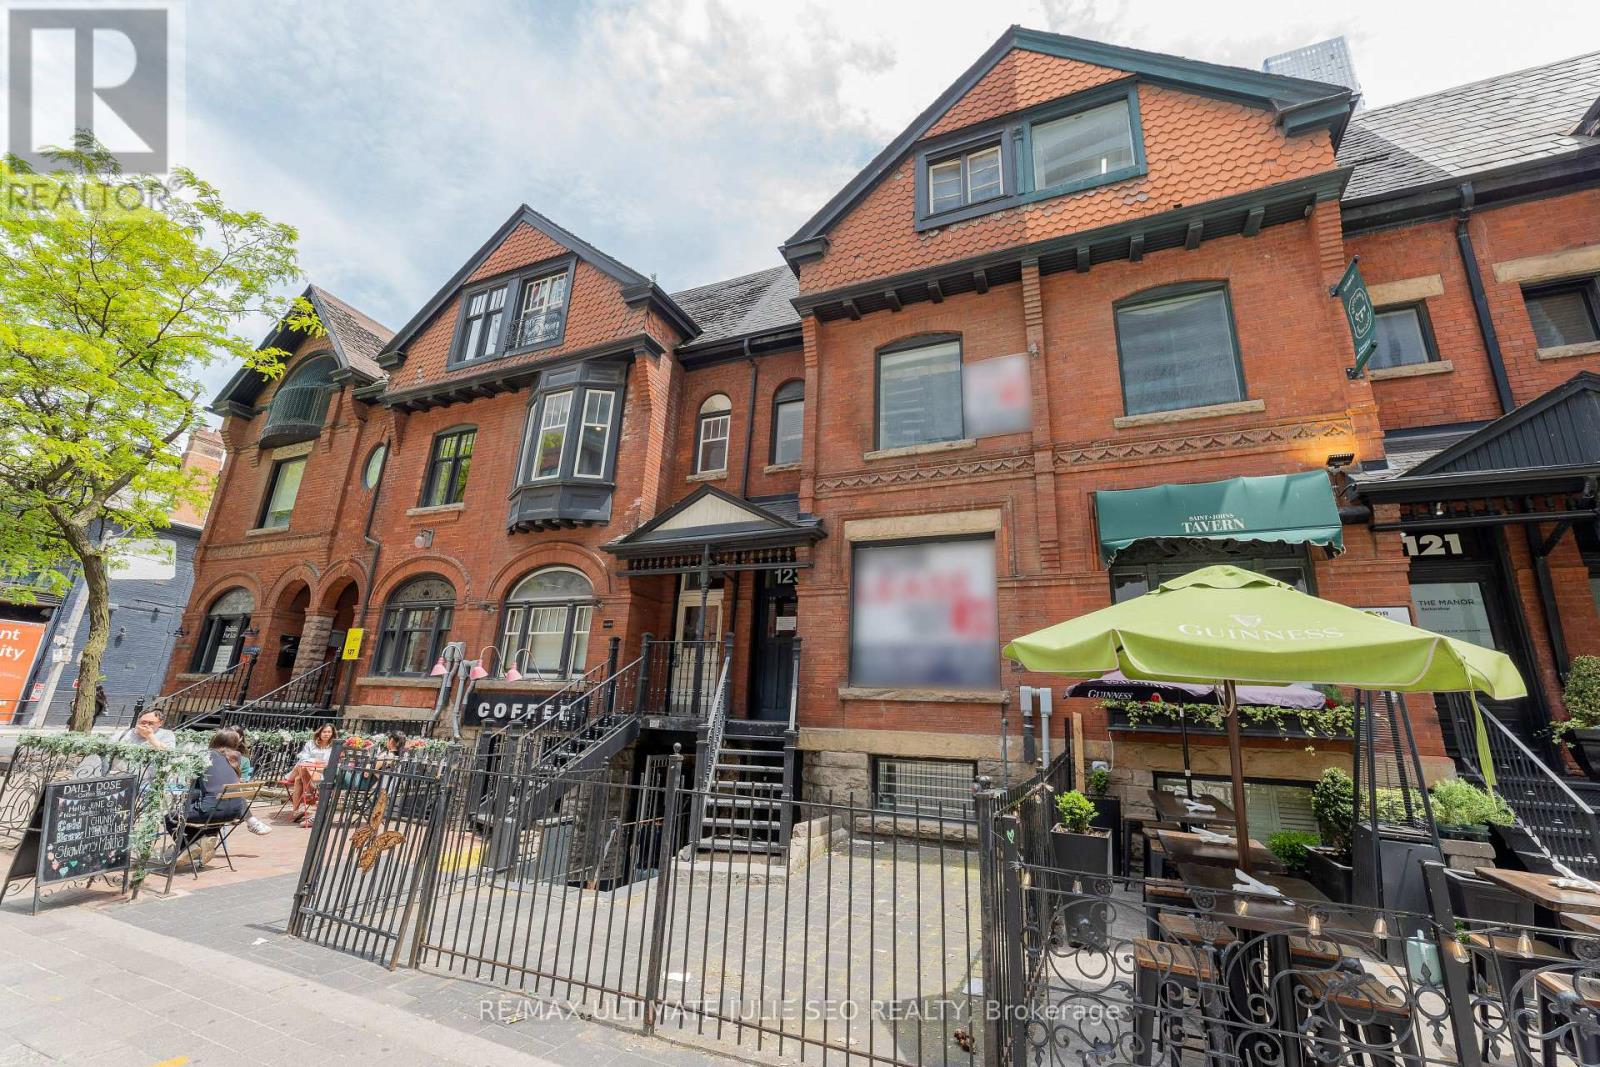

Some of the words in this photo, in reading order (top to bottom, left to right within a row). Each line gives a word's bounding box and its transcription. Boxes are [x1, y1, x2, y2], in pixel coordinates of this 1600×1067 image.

[1181, 518, 1248, 534] TAVERN
[1401, 533, 1463, 556] 121
[1178, 624, 1344, 641] GUINNESS
[1088, 689, 1133, 699] GUINNESS
[64, 783, 93, 794] DAILY
[96, 780, 121, 790] DOSE
